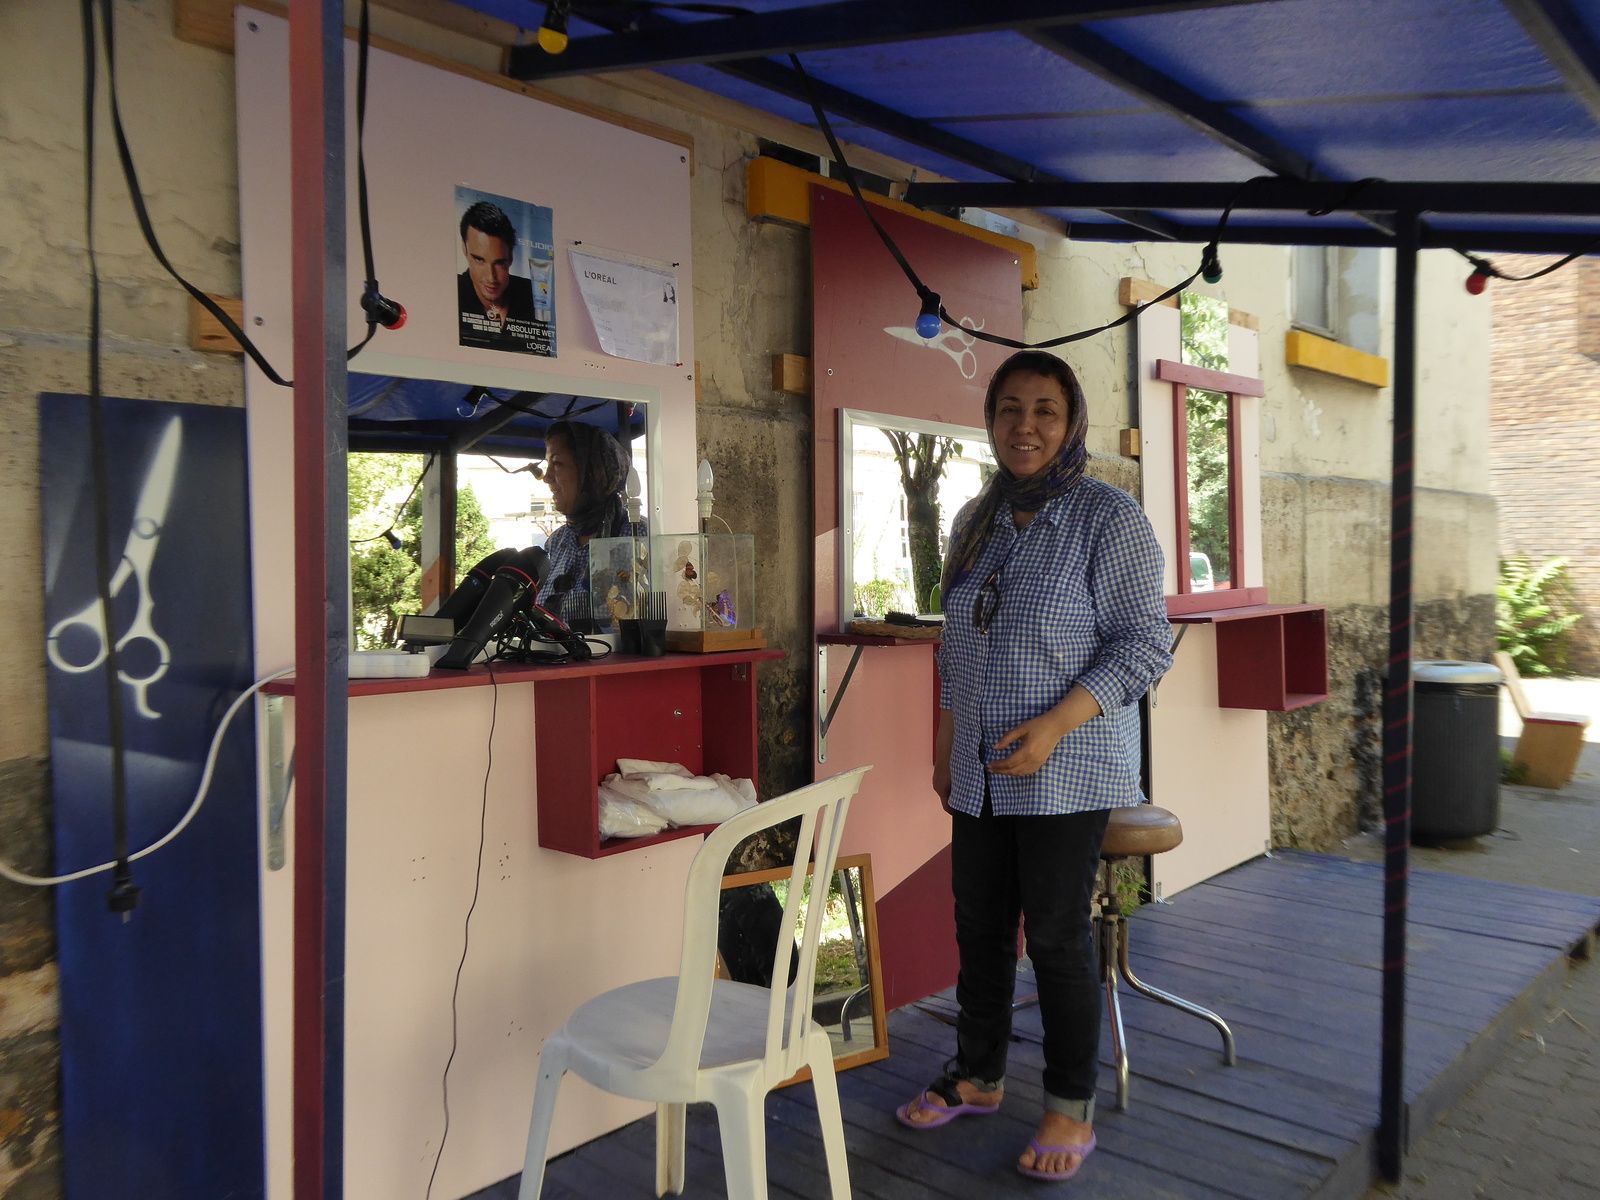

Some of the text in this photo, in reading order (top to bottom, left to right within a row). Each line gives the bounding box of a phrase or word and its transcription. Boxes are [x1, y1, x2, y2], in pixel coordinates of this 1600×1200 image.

[517, 238, 554, 250] STUDIO
[506, 323, 541, 336] ABSOLUTE
[541, 329, 556, 338] WET
